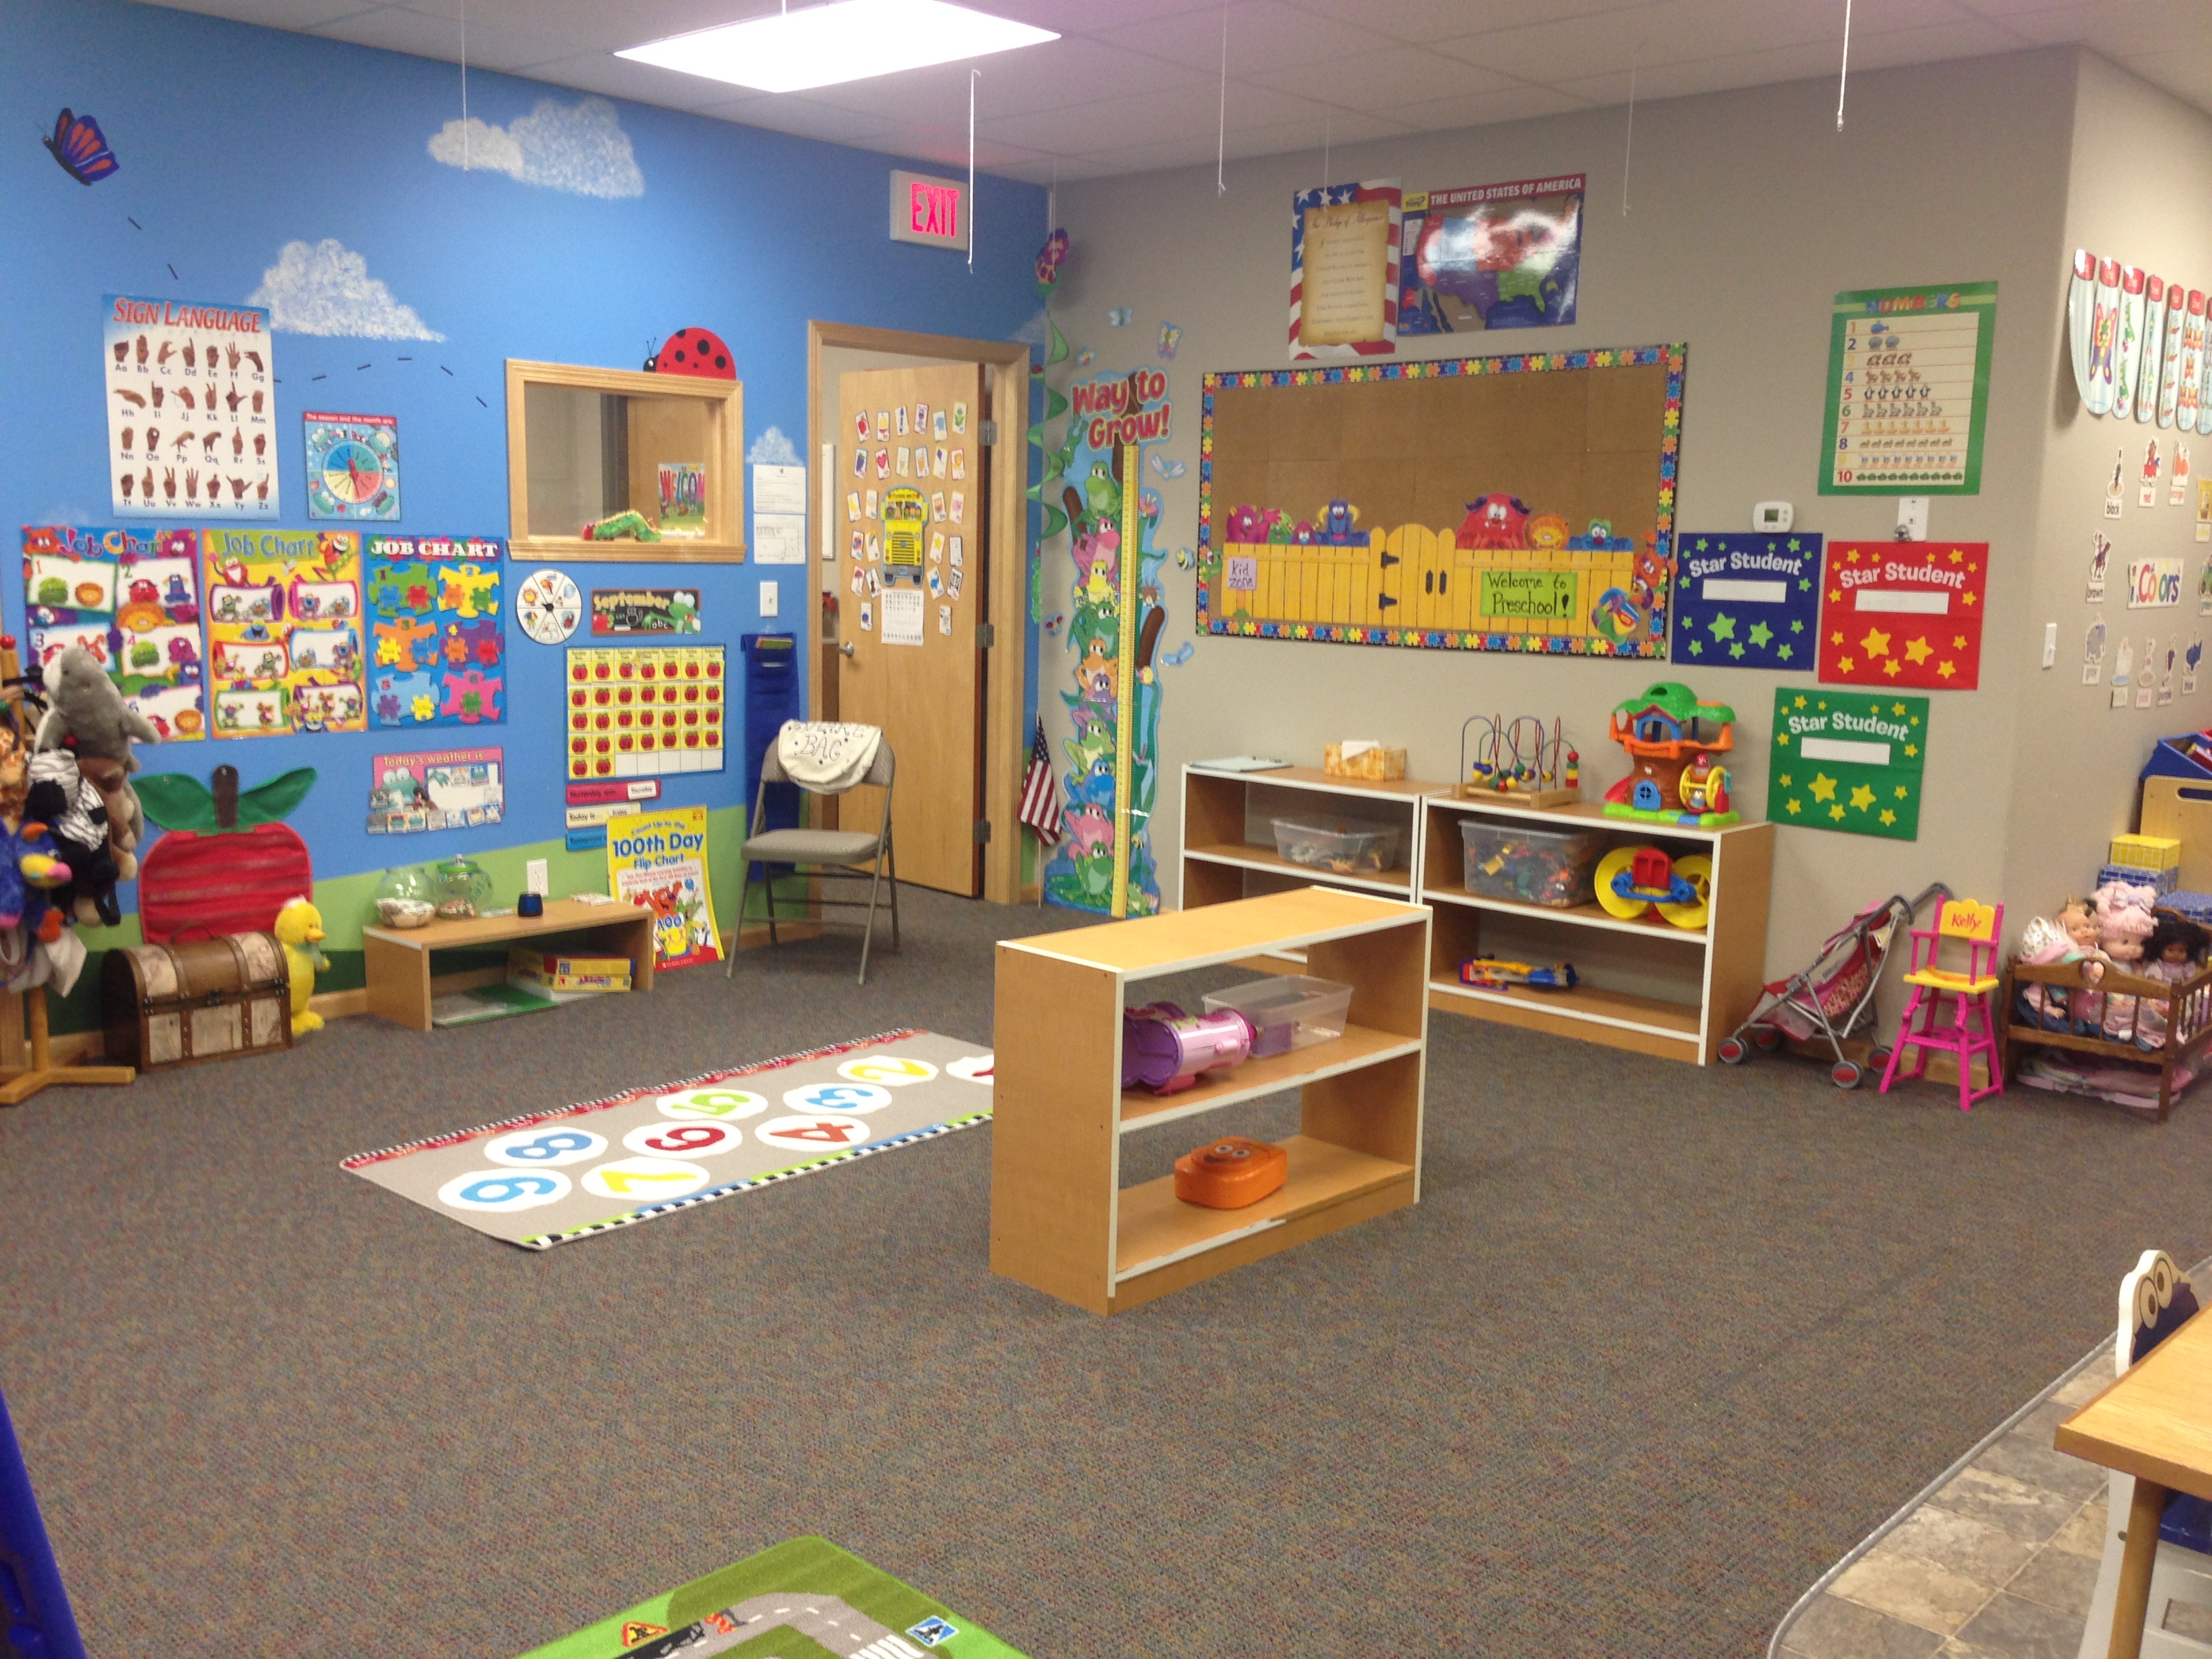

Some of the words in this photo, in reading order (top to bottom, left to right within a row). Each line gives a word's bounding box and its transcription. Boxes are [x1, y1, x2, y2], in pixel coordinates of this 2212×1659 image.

[1431, 194, 1448, 205] THE
[1450, 190, 1483, 203] UNITED
[1486, 186, 1520, 199] STATES
[1522, 183, 1534, 194] OF
[1536, 178, 1581, 193] AMERICA
[912, 183, 960, 238] EXIT
[1866, 293, 1961, 314] NUMBERS
[112, 298, 160, 325] SIGN
[163, 302, 262, 333] LANGUAGE
[1850, 322, 1856, 333] 1
[1847, 339, 1856, 350] 2
[1845, 371, 1854, 383] 4
[1071, 381, 1129, 415] Way
[1136, 370, 1166, 401] to
[1843, 388, 1852, 400] 5
[1842, 405, 1851, 417] 6
[1088, 405, 1170, 450] Grow!
[1841, 422, 1850, 433] 7
[1839, 438, 1847, 450] 8
[1838, 470, 1852, 483] 10
[56, 529, 103, 557] Job
[103, 529, 164, 556] Chart
[222, 532, 255, 556] Job
[262, 533, 315, 557] Chart
[371, 540, 415, 555] JOB
[418, 541, 498, 556] CHART
[37, 560, 42, 574] 1
[121, 565, 133, 579] 2
[1689, 556, 1727, 577] Star
[1730, 551, 1803, 575] Student
[1488, 572, 1543, 589] Welcome
[1553, 574, 1567, 590] to
[1839, 567, 1881, 588] Star
[1885, 561, 1966, 589] Student
[594, 591, 670, 611] September
[652, 619, 668, 629] abc
[1788, 716, 1828, 734] Star
[1832, 711, 1909, 741] Student
[384, 755, 424, 767] Today's
[428, 752, 471, 764] weather
[476, 752, 483, 760] is
[569, 813, 588, 822] Today
[613, 835, 665, 857] 100th
[670, 832, 703, 852] Day
[634, 858, 652, 871] Flip
[655, 853, 684, 866] Chart
[657, 914, 682, 932] 100
[1952, 913, 1981, 933] Kelly
[849, 1059, 929, 1077] 2
[672, 1093, 750, 1115] 5
[804, 1087, 873, 1109] 3
[769, 1122, 854, 1142] 4
[506, 1132, 592, 1159] 8
[600, 1170, 698, 1193] 7
